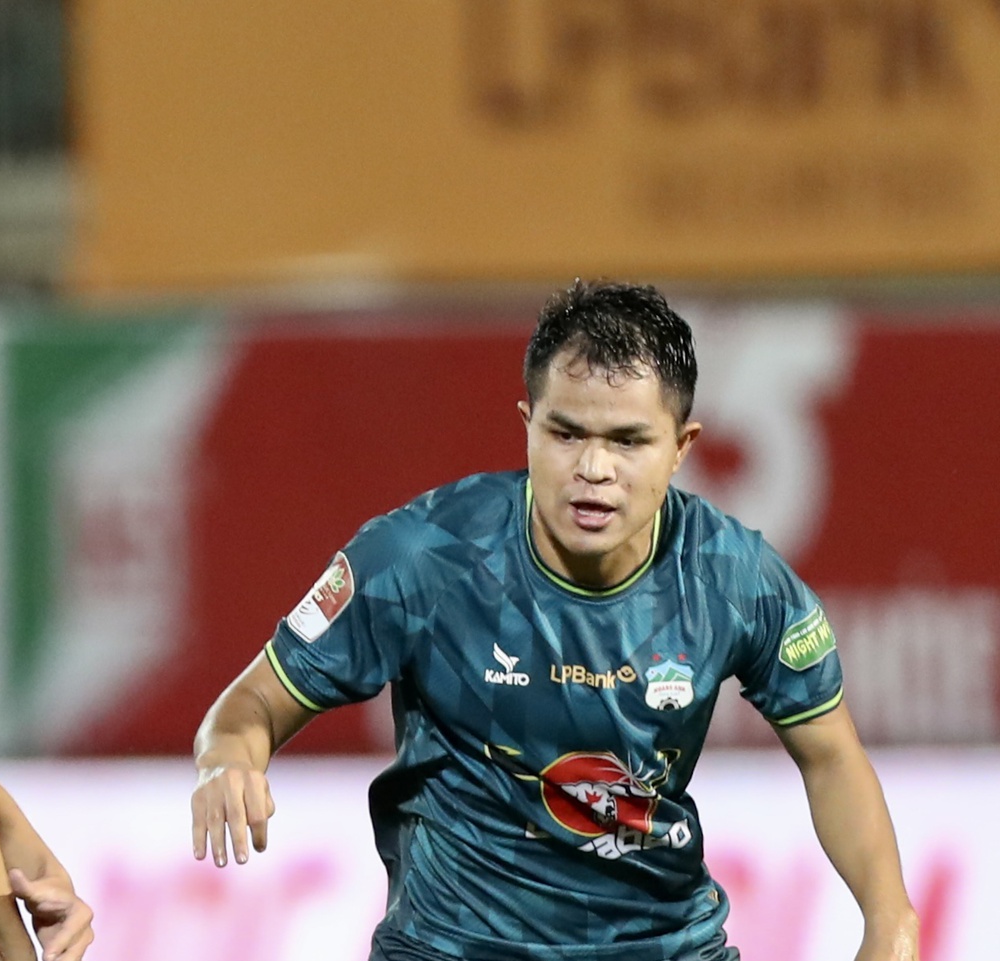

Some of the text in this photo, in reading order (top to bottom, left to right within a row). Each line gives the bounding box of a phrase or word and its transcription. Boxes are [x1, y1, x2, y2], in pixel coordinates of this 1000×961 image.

[785, 631, 820, 664] NIGHT
[485, 669, 530, 687] KAMITO
[550, 664, 616, 689] LPBank
